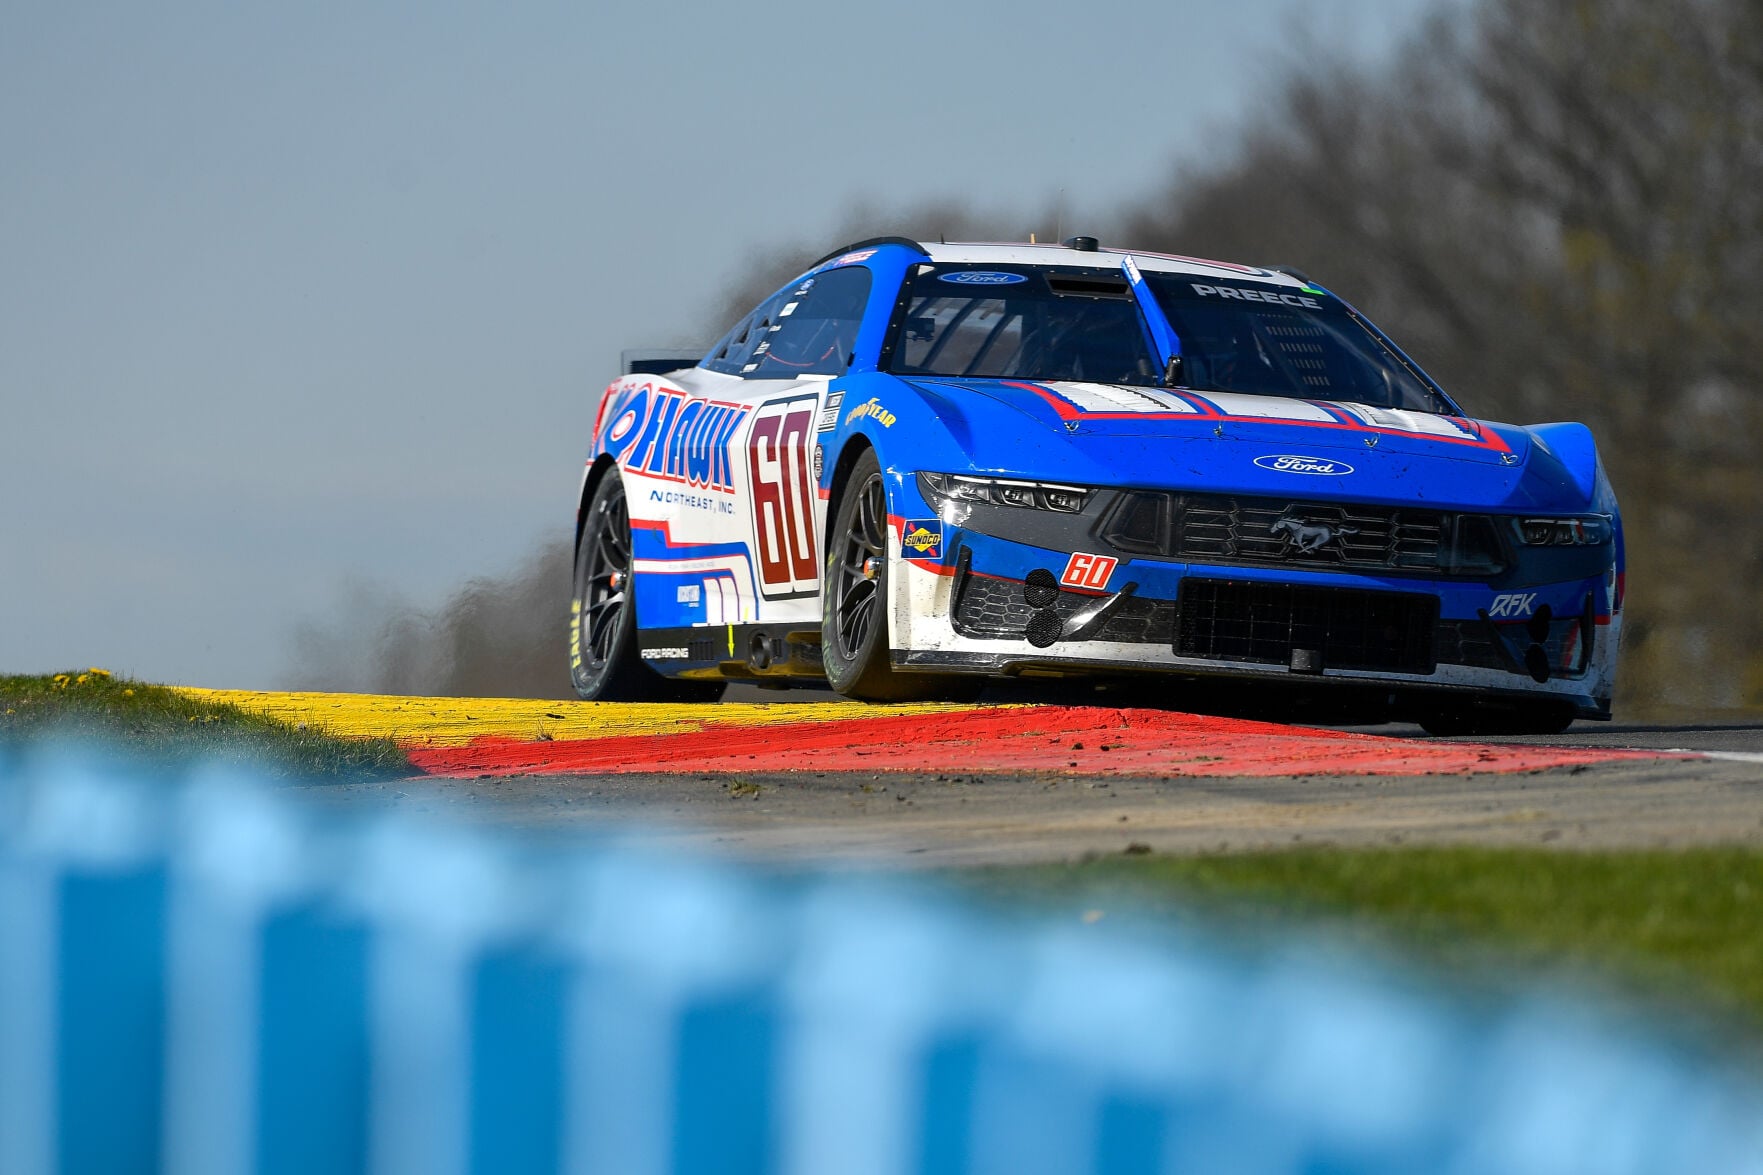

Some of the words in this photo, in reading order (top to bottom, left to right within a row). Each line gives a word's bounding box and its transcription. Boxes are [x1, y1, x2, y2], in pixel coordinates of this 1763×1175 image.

[956, 272, 1009, 282] Ford
[1190, 283, 1323, 310] PREECE
[1273, 456, 1334, 473] Ford
[650, 489, 717, 514] NORTHEAST,
[718, 501, 736, 514] INC.
[748, 408, 819, 585] 60
[906, 535, 939, 545] SUNOCO
[1065, 555, 1115, 587] 60
[1488, 592, 1537, 617] RFK
